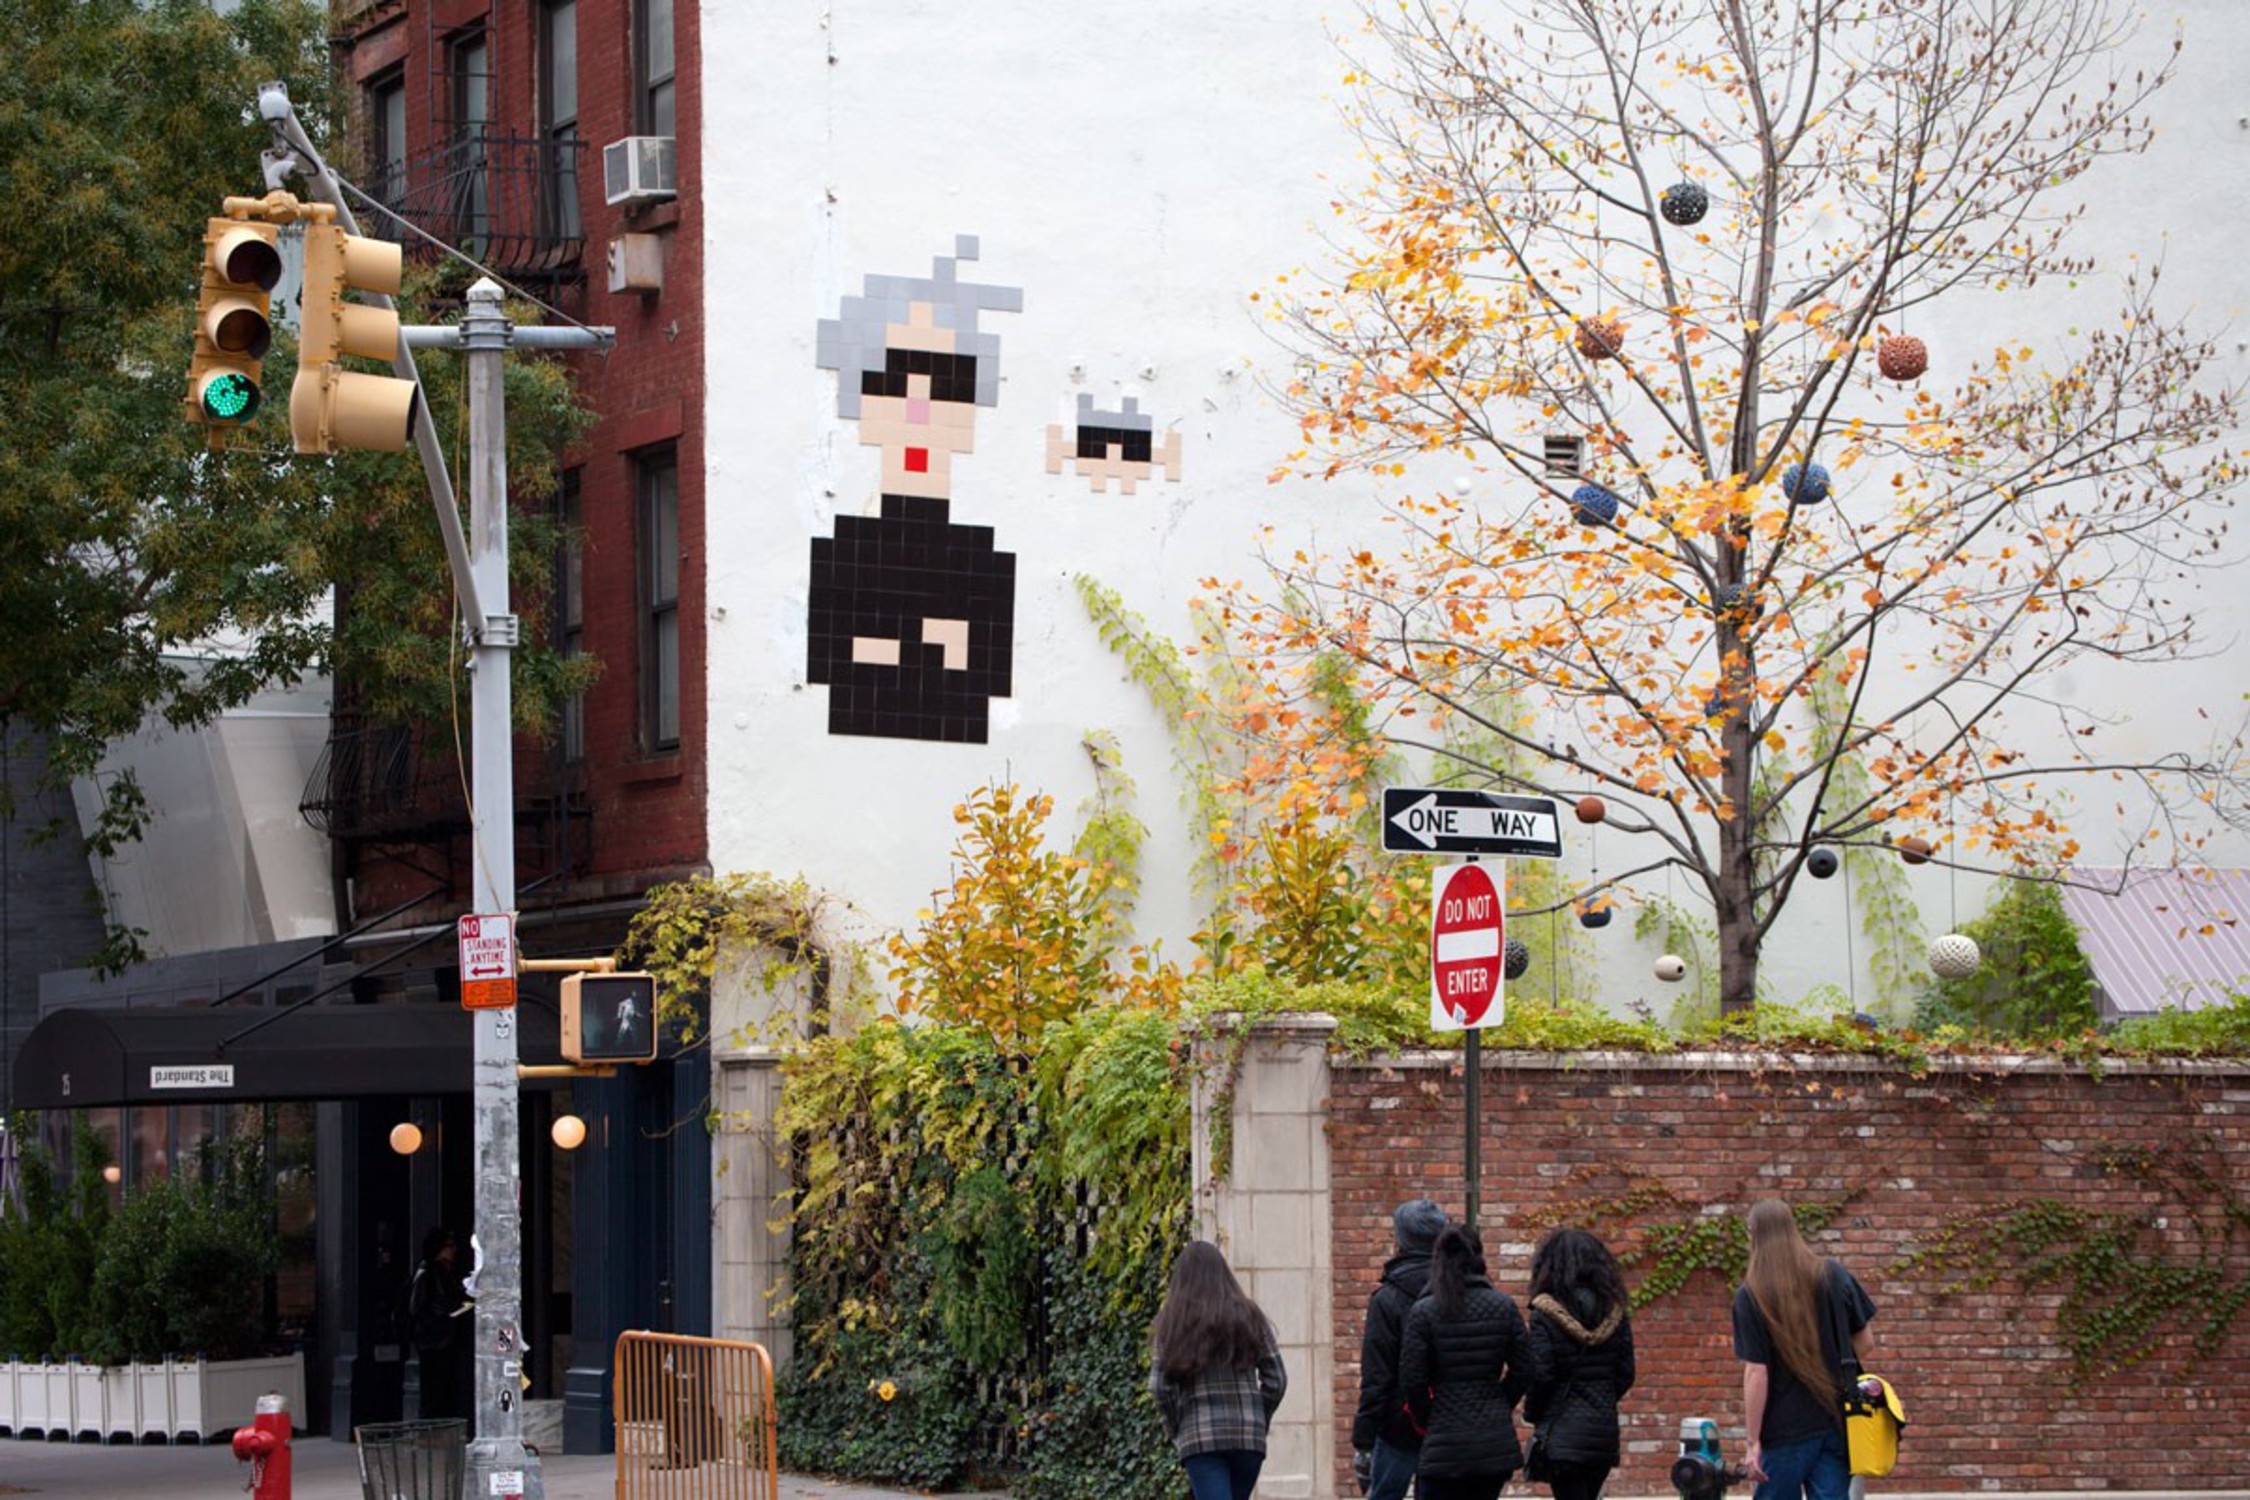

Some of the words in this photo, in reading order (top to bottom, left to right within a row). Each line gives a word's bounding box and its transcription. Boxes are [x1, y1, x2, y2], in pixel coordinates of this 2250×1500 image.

[1409, 809, 1458, 833] ONE
[1491, 811, 1536, 838] WAY
[1445, 899, 1463, 923] DO
[1467, 895, 1491, 921] NOT
[462, 920, 479, 936] NO
[466, 937, 507, 952] STANDING
[470, 951, 505, 964] ANYTIME
[1448, 967, 1488, 995] ENTER
[155, 1070, 207, 1083] Standard
[209, 1070, 229, 1083] The
